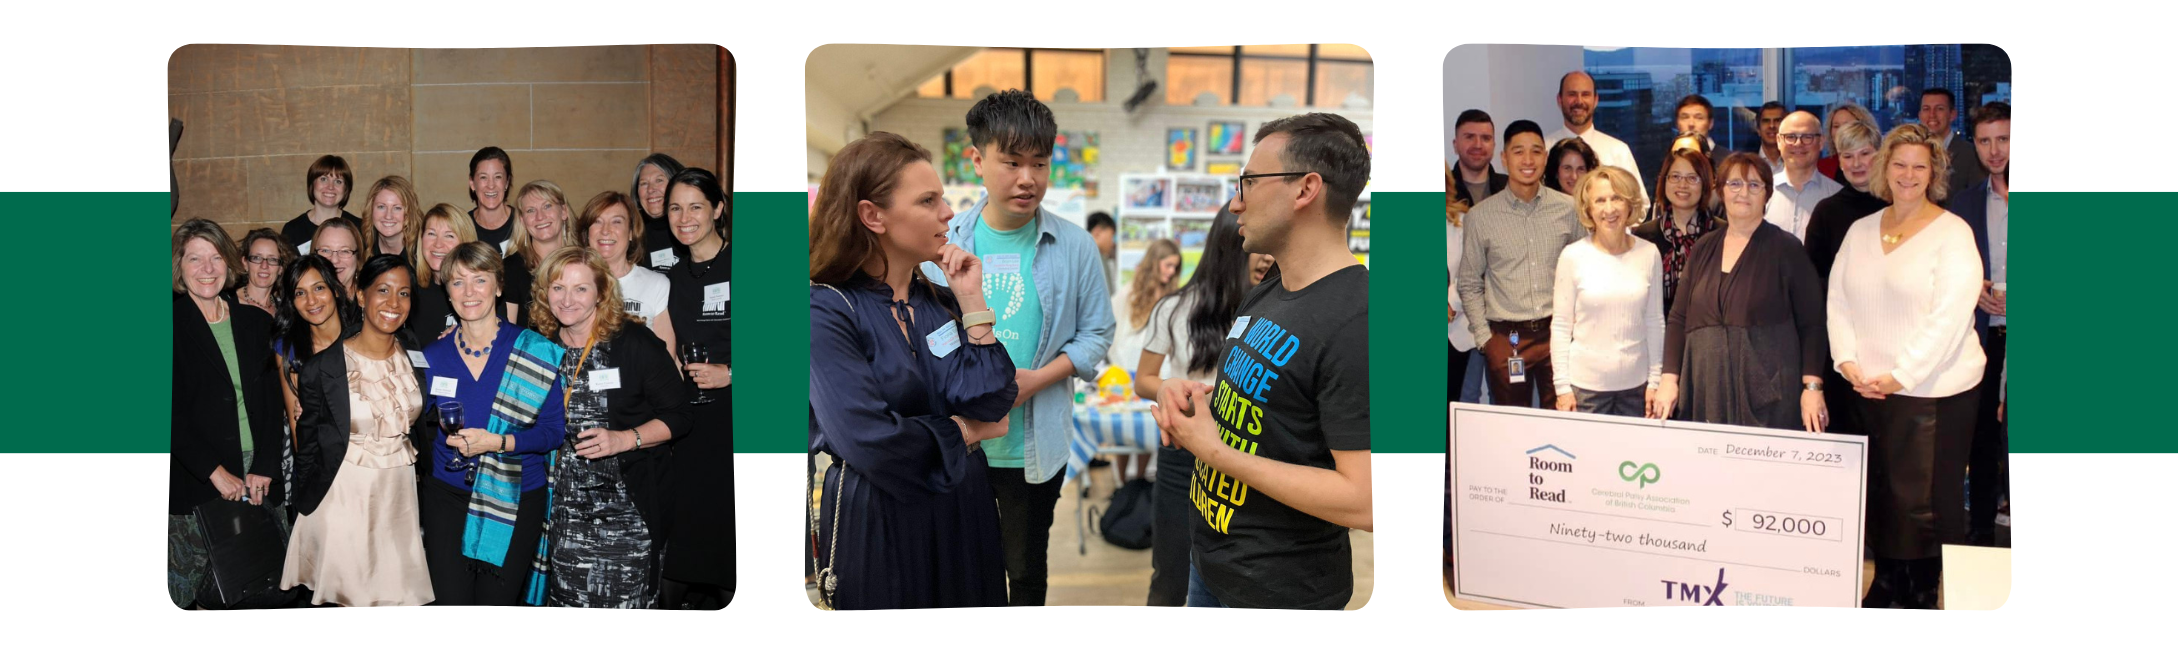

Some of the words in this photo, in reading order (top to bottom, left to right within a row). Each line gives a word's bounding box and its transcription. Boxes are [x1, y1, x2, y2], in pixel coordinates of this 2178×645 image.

[1243, 316, 1300, 367] WORLD
[1223, 345, 1279, 403] CHANGE
[1213, 379, 1264, 436] STARTS
[1697, 446, 1718, 455] DATE
[1726, 443, 1786, 459] December
[1791, 450, 1802, 461] 7,
[1806, 451, 1842, 464] 2023
[1529, 456, 1573, 473] Room
[1529, 472, 1544, 485] to
[1469, 493, 1494, 502] ORDER
[1495, 495, 1505, 503] OF
[1483, 486, 1493, 494] TO
[1494, 487, 1507, 495] THE
[1529, 486, 1566, 503] Read
[1591, 487, 1624, 498] Cerebral
[1625, 491, 1645, 502] Palsy
[1646, 494, 1690, 505] Association
[1614, 499, 1636, 508] British
[1638, 502, 1676, 513] Columbia
[1721, 509, 1733, 528] $
[1752, 513, 1826, 536] 92,000
[1549, 522, 1633, 544] Ninety-two
[1638, 533, 1708, 553] thousand
[1803, 566, 1842, 577] DOLLARS
[1660, 567, 1729, 606] TMX
[1623, 598, 1646, 607] FROM
[1734, 590, 1752, 601] THE
[1755, 593, 1794, 606] FUTURE
